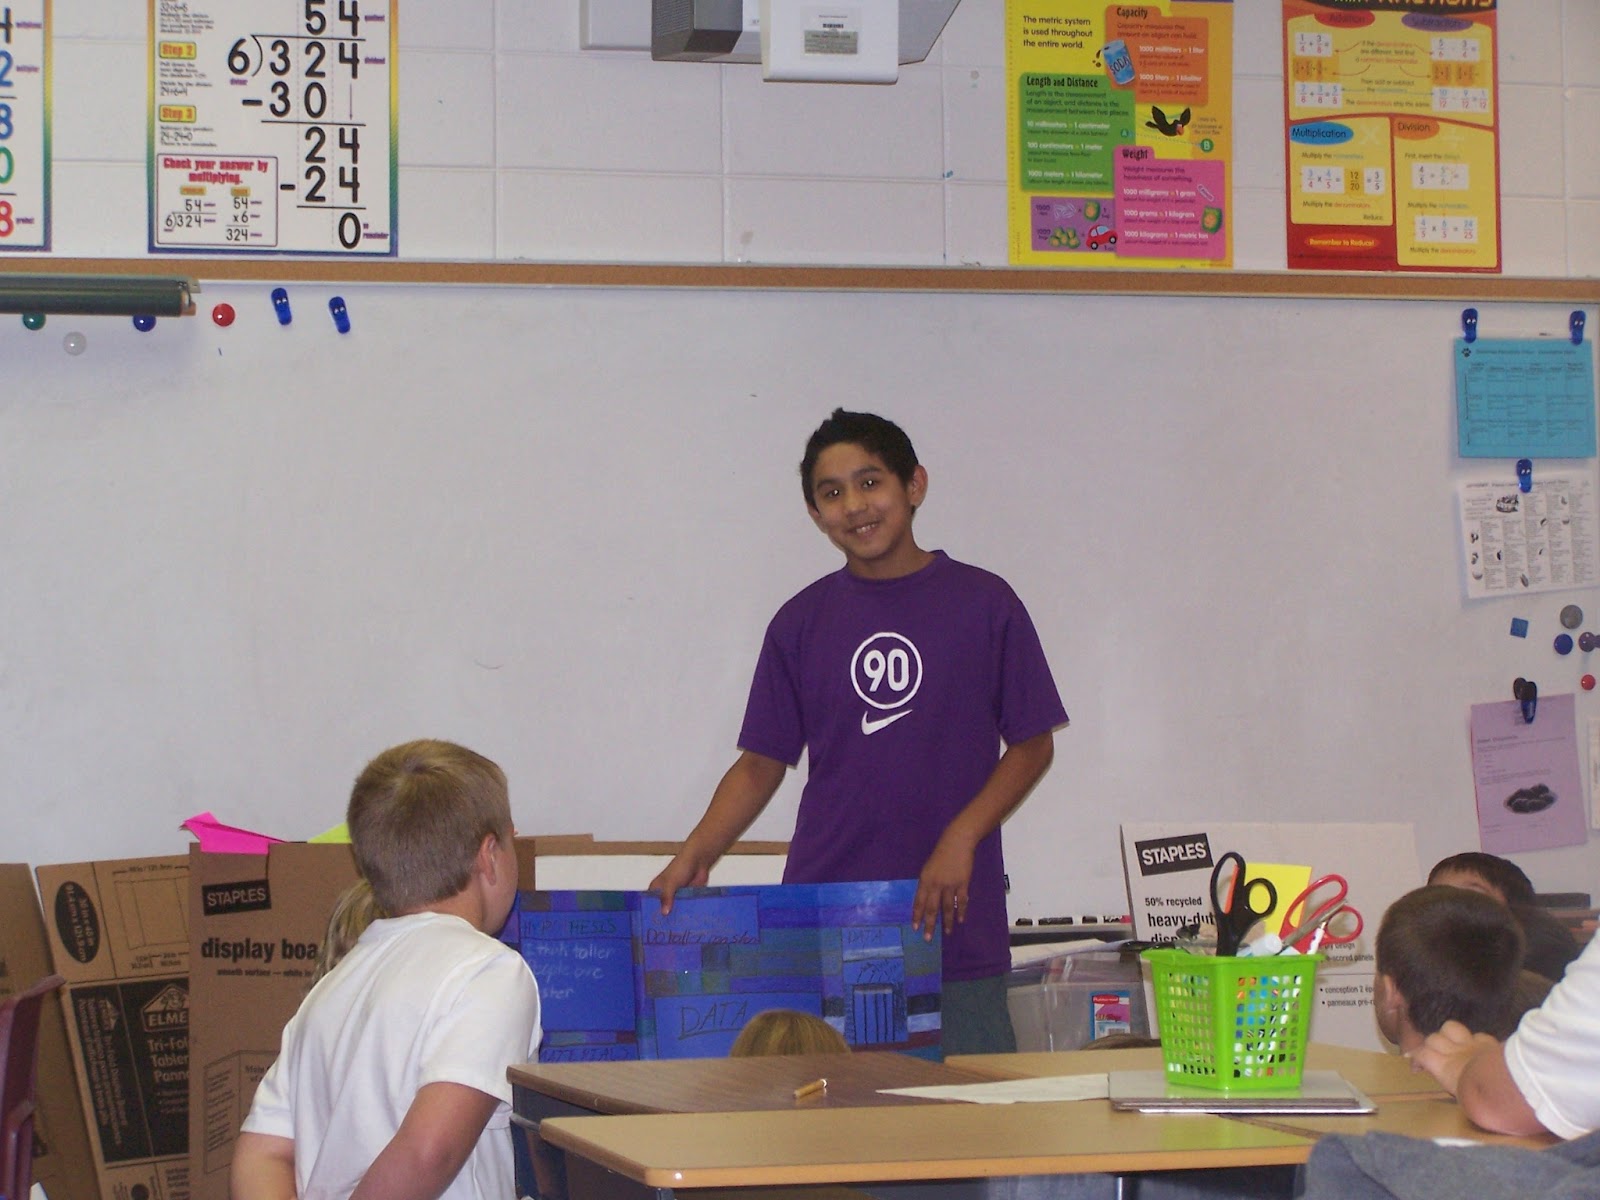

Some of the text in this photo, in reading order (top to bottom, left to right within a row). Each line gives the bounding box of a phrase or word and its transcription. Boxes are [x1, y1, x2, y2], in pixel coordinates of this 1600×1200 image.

[1116, 7, 1148, 20] Capacity
[1023, 16, 1091, 27] The metric system
[1031, 28, 1050, 36] used
[1052, 28, 1093, 38] throughout
[1024, 39, 1084, 49] the entire world.
[1110, 55, 1130, 76] SODA
[1026, 76, 1098, 88] Length and Distance
[1292, 122, 1431, 139] Multiplication Division
[1203, 140, 1210, 150] B
[1122, 148, 1148, 160] Weight
[164, 158, 268, 172] Check your answer by
[189, 172, 243, 184] multiplying.
[1350, 172, 1359, 180] 12
[864, 648, 909, 692] 90
[1142, 842, 1207, 866] STAPLES
[207, 888, 266, 907] STAPLES
[1145, 896, 1202, 908] 50% recycled
[1148, 912, 1216, 929] heavy-dut
[201, 938, 275, 964] display
[282, 938, 318, 960] boa
[573, 943, 612, 960] taller
[542, 986, 574, 1000] ster
[1324, 986, 1358, 994] conception
[1328, 1000, 1356, 1008] panneaux
[148, 1013, 188, 1028] ELME
[682, 1001, 749, 1034] DATA
[148, 1038, 188, 1053] Tri-Fol
[151, 1055, 188, 1068] Tabler
[154, 1070, 188, 1083] Pann
